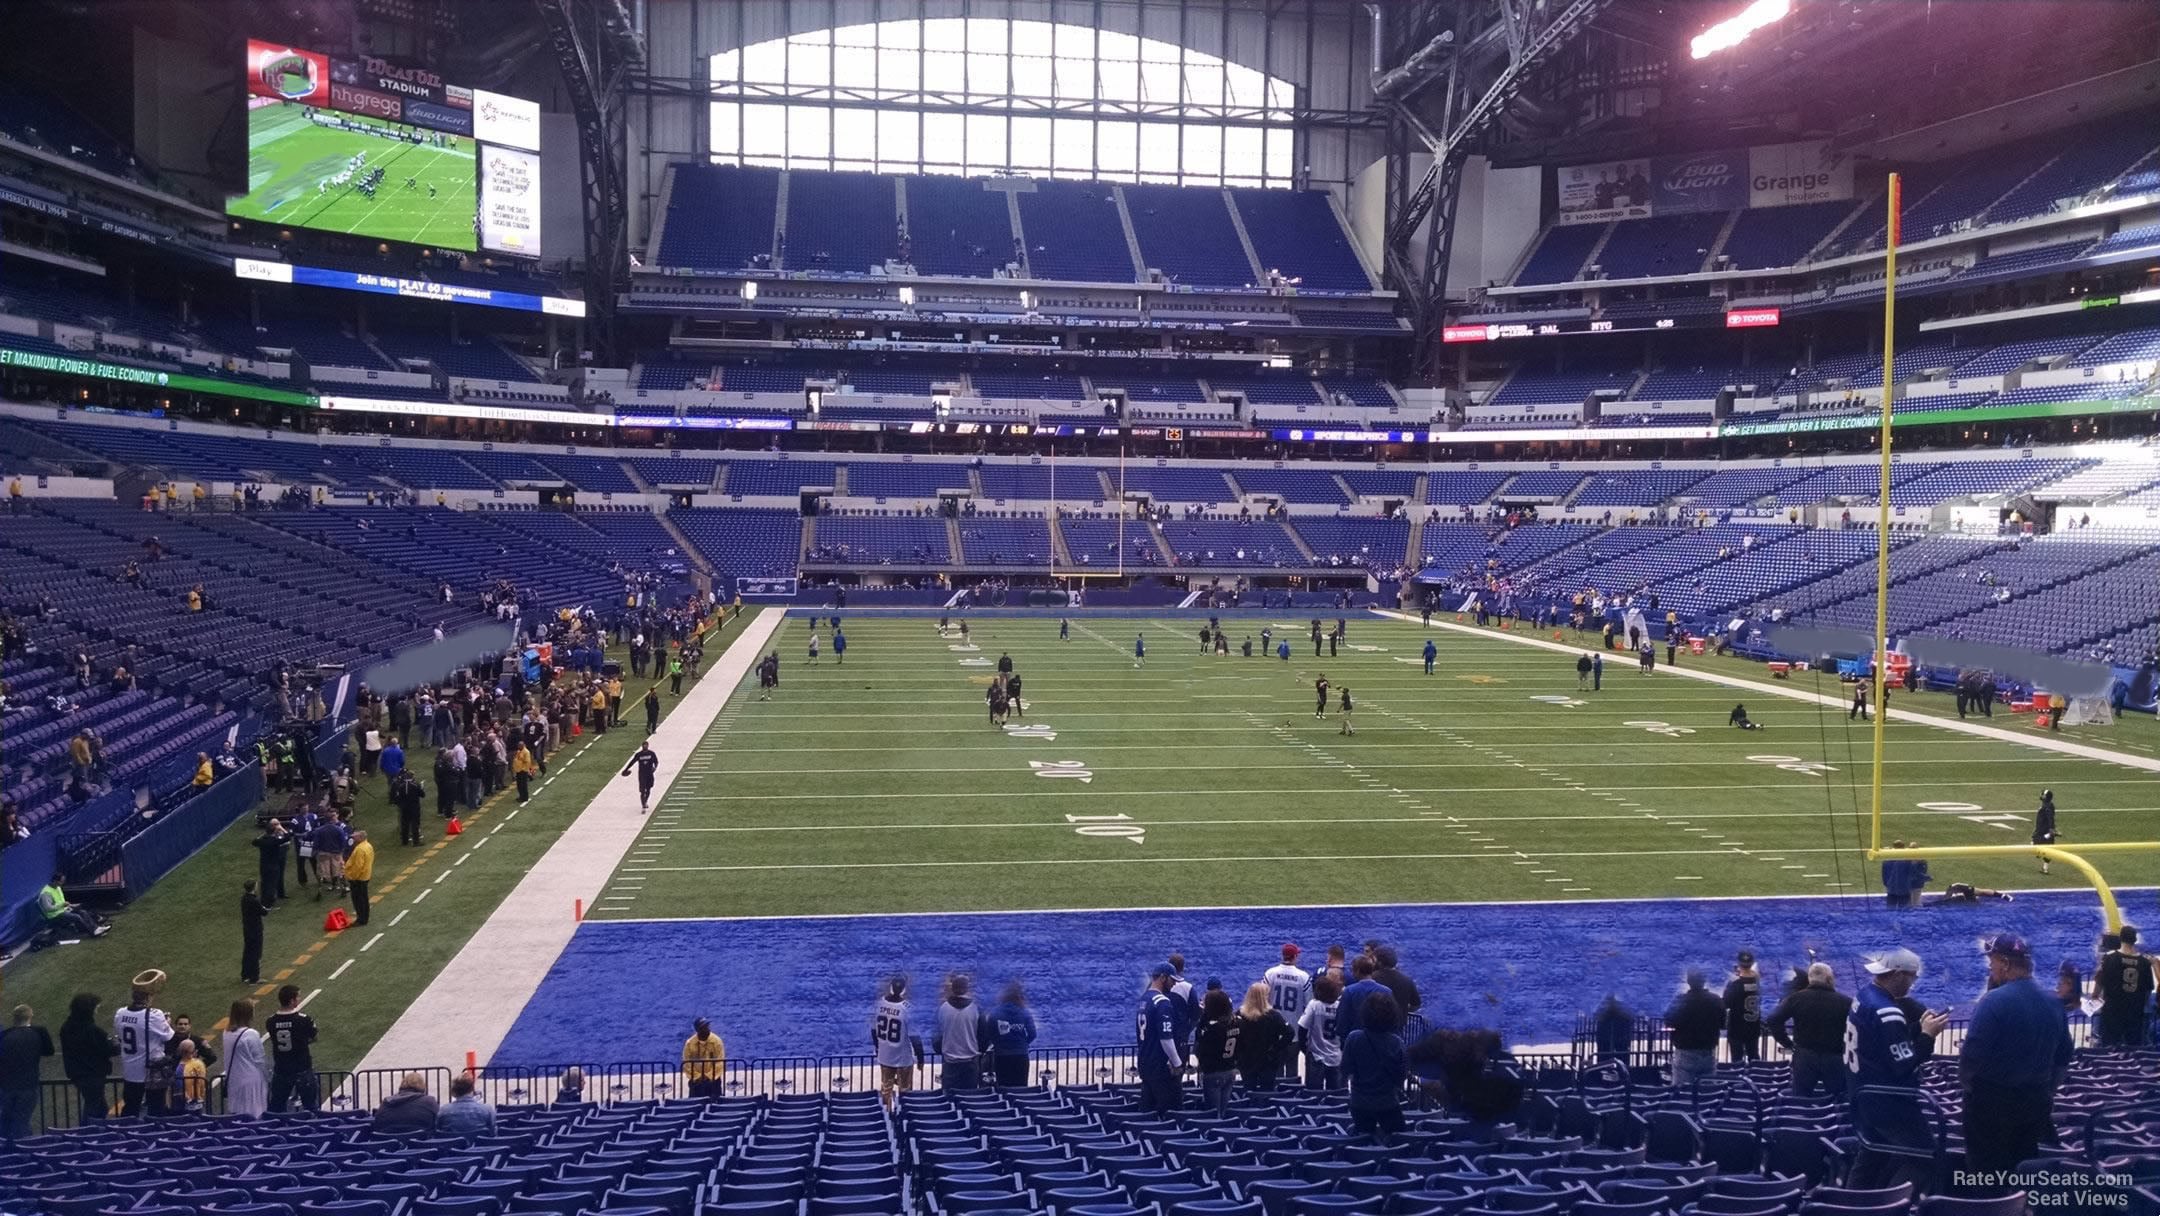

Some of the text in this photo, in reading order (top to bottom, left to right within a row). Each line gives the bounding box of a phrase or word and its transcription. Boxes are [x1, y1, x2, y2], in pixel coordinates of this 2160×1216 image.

[361, 56, 441, 88] LUCAS OIL
[379, 78, 429, 97] STADIUM
[411, 108, 468, 126] BUD LIGHT
[1686, 164, 1729, 177] BUD
[1675, 175, 1733, 189] LIGHT
[1753, 172, 1830, 191] Grange
[1784, 190, 1830, 201] Insurance
[27, 199, 46, 212] FAULK
[114, 226, 138, 239] SATURDAY
[356, 274, 491, 300] Join the PLAY 60 movement
[1591, 322, 1612, 330] NYG
[1743, 314, 1777, 322] TOYOTA
[1456, 330, 1485, 338] TOYOTA
[1540, 325, 1559, 334] DAL
[0, 350, 156, 383] ET MAXIMUM POWER & FUEL ECONOMY
[1168, 429, 1180, 439] 25
[1741, 426, 1754, 435] GET
[1755, 424, 1788, 434] MAXIMUM
[1814, 421, 1819, 430] &
[1821, 420, 1838, 430] FUEL
[1841, 417, 1879, 428] ECONOMY
[1028, 760, 1093, 778] 20
[1916, 801, 2032, 823] 10
[1065, 812, 1146, 836] 10
[2122, 967, 2139, 992] 9
[1273, 985, 1298, 1012] 18
[879, 1006, 900, 1016] SPILLER
[1744, 995, 1760, 1022] 9
[122, 1015, 138, 1025] BREES
[1162, 1021, 1172, 1032] 12
[877, 1016, 901, 1043] 28
[123, 1027, 137, 1054] 9
[277, 1030, 292, 1051] 9
[1223, 1037, 1237, 1059] 9
[1889, 1040, 1914, 1061] 98
